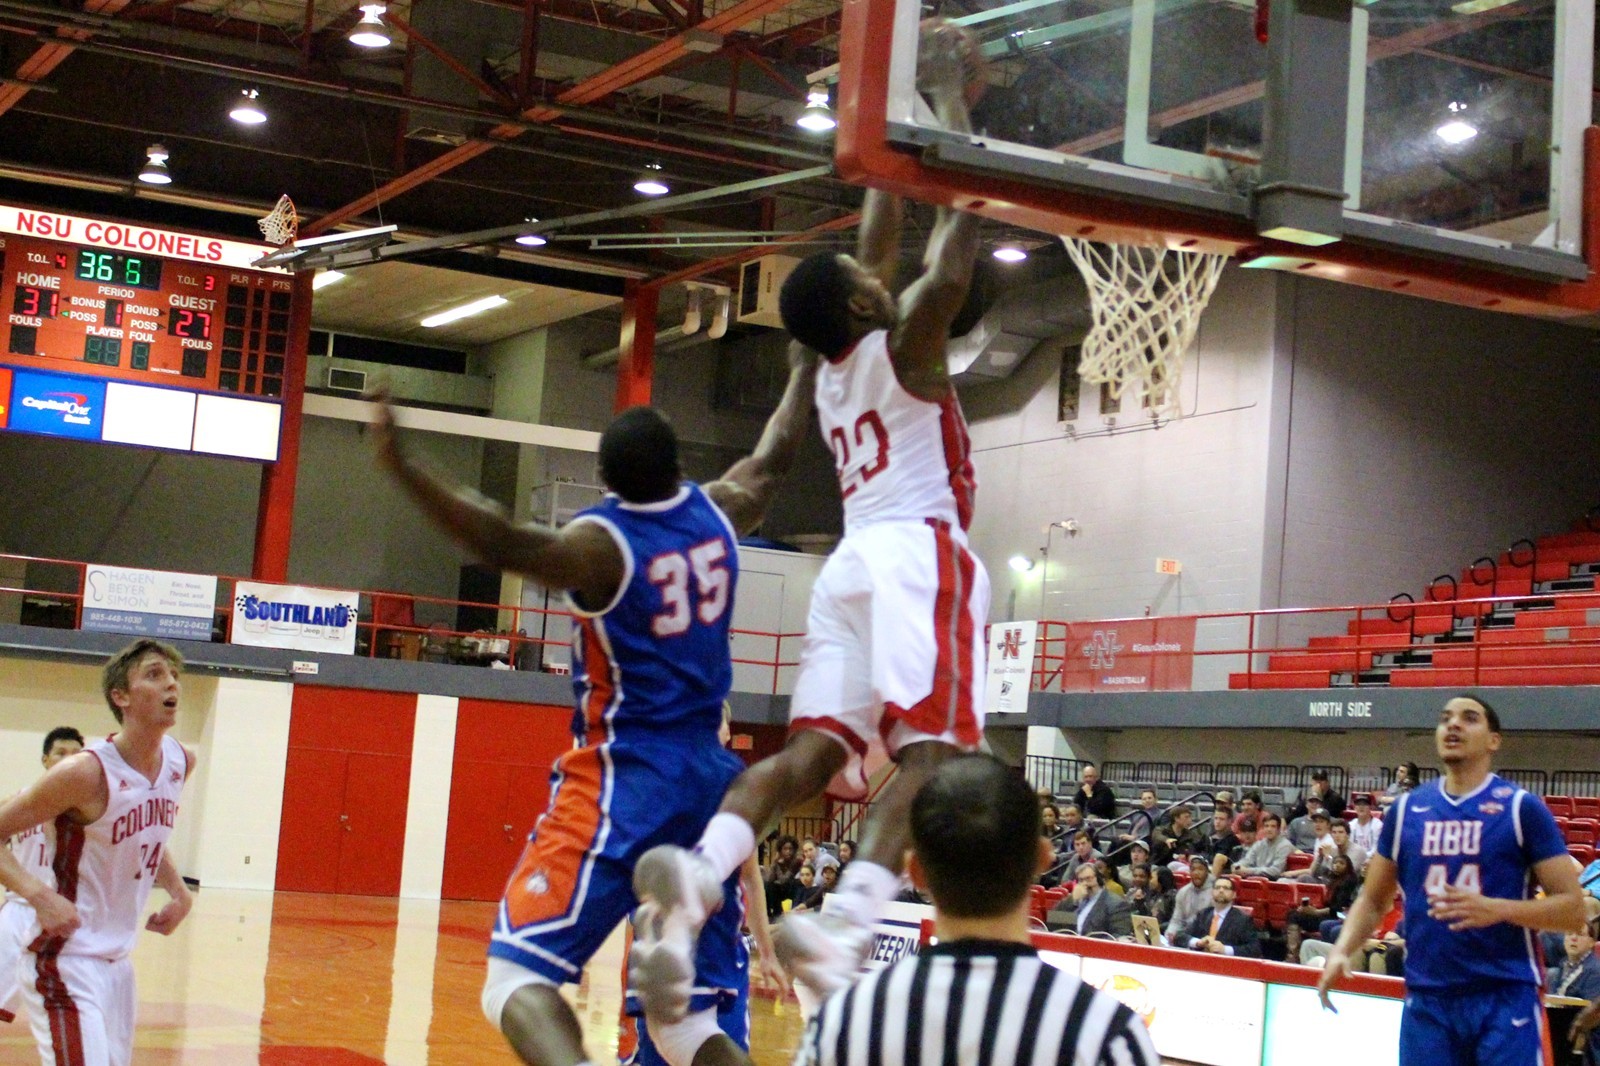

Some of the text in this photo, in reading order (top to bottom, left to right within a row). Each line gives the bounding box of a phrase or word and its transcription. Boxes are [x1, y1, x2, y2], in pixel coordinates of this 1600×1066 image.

[16, 211, 223, 262] NSU COLONELS
[56, 254, 67, 268] 4
[16, 271, 61, 290] HOME
[204, 275, 215, 291] 3
[230, 273, 249, 285] PLR
[257, 276, 264, 286] F
[272, 280, 291, 291] PTS
[98, 285, 136, 299] PERIOD
[22, 287, 58, 317] 31
[71, 296, 106, 309] BONUS
[168, 293, 218, 312] GUEST
[69, 310, 97, 323] POSS
[115, 303, 122, 326] 1
[125, 303, 159, 317] BONUS
[8, 313, 43, 328] FOULS
[130, 319, 157, 332] POSS
[175, 310, 211, 339] 27
[86, 325, 124, 339] PLAYER
[129, 331, 155, 344] FOUL
[181, 337, 213, 351] FOULS
[830, 408, 891, 501] 23
[1162, 560, 1175, 572] EXIT
[108, 570, 155, 585] HAGEN
[107, 583, 145, 596] BEYER
[646, 536, 731, 639] 35
[106, 595, 150, 608] SIMON
[244, 595, 349, 628] SOUTHLAND
[304, 626, 321, 636] Jeep
[1309, 701, 1373, 718] NORTH SIDE
[1421, 819, 1484, 857] HBU
[1424, 863, 1481, 905] 44
